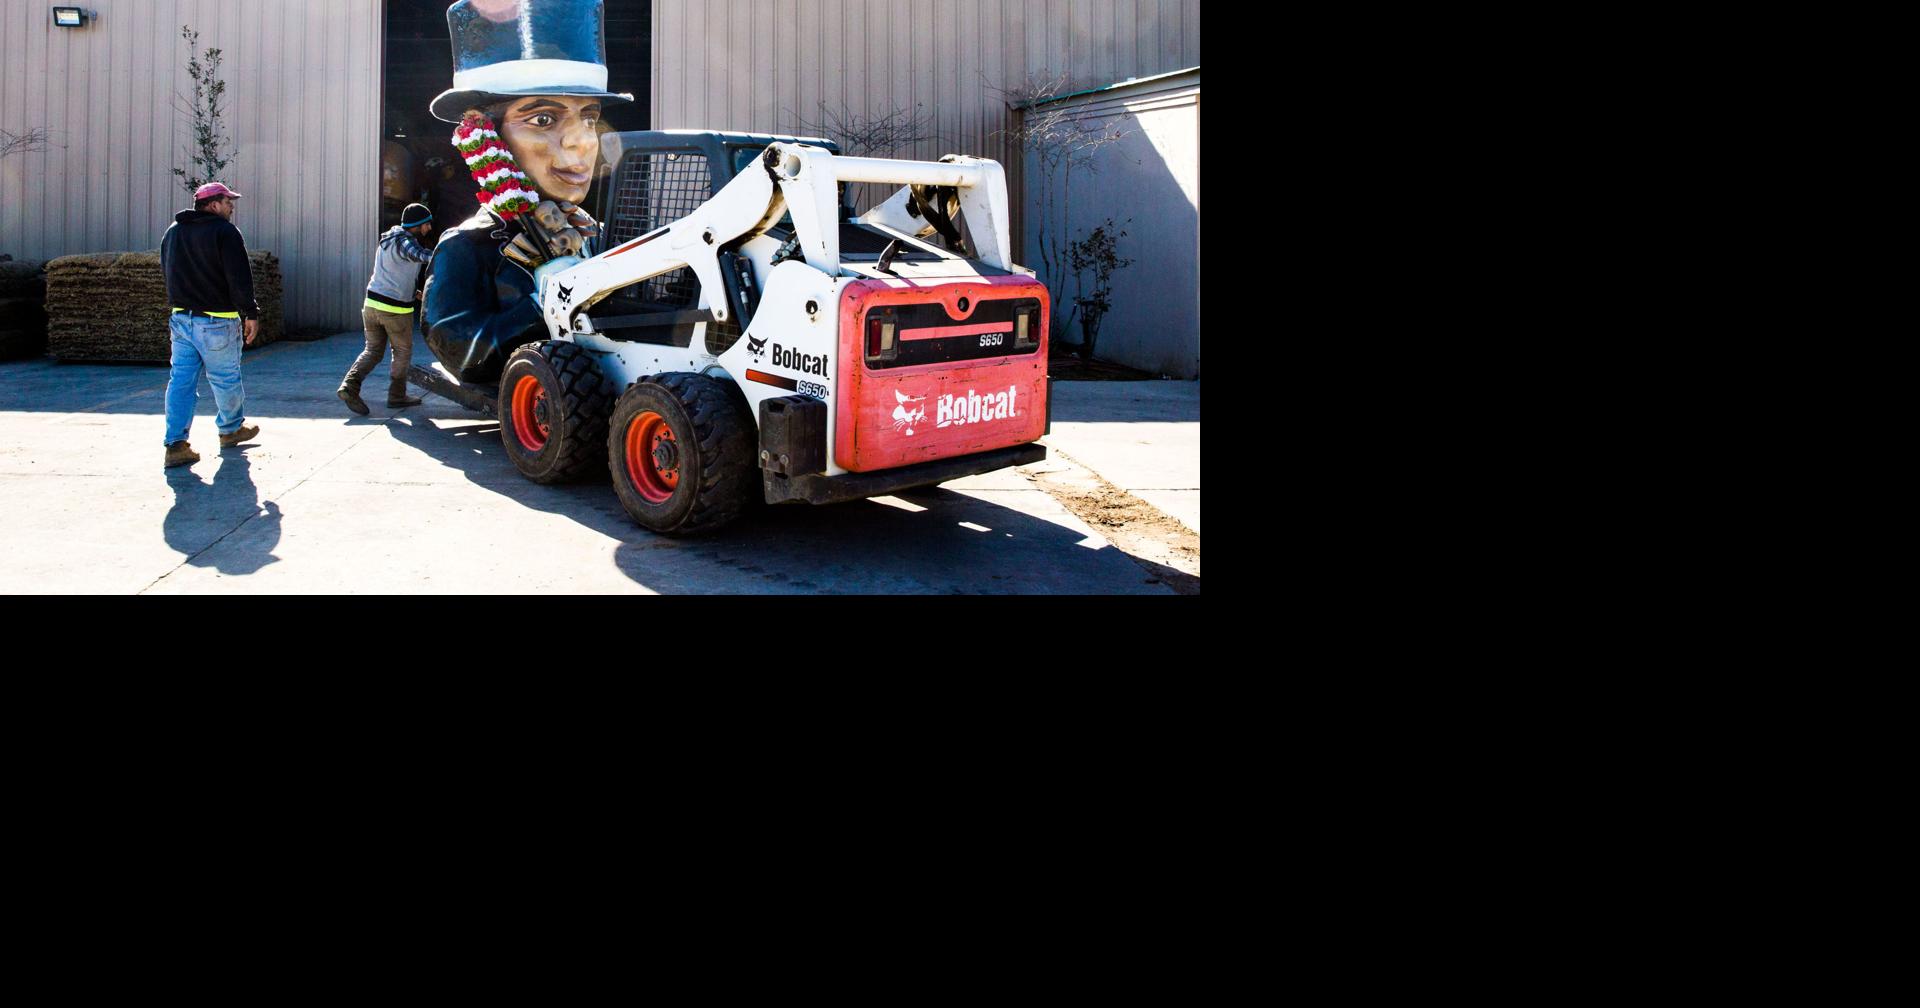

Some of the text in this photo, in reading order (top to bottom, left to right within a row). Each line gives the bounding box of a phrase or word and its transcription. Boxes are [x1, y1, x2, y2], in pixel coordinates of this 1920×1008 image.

[979, 333, 1003, 347] S650
[772, 343, 828, 377] Bobcat
[798, 380, 826, 399] S650
[936, 385, 1017, 428] Bobcat
